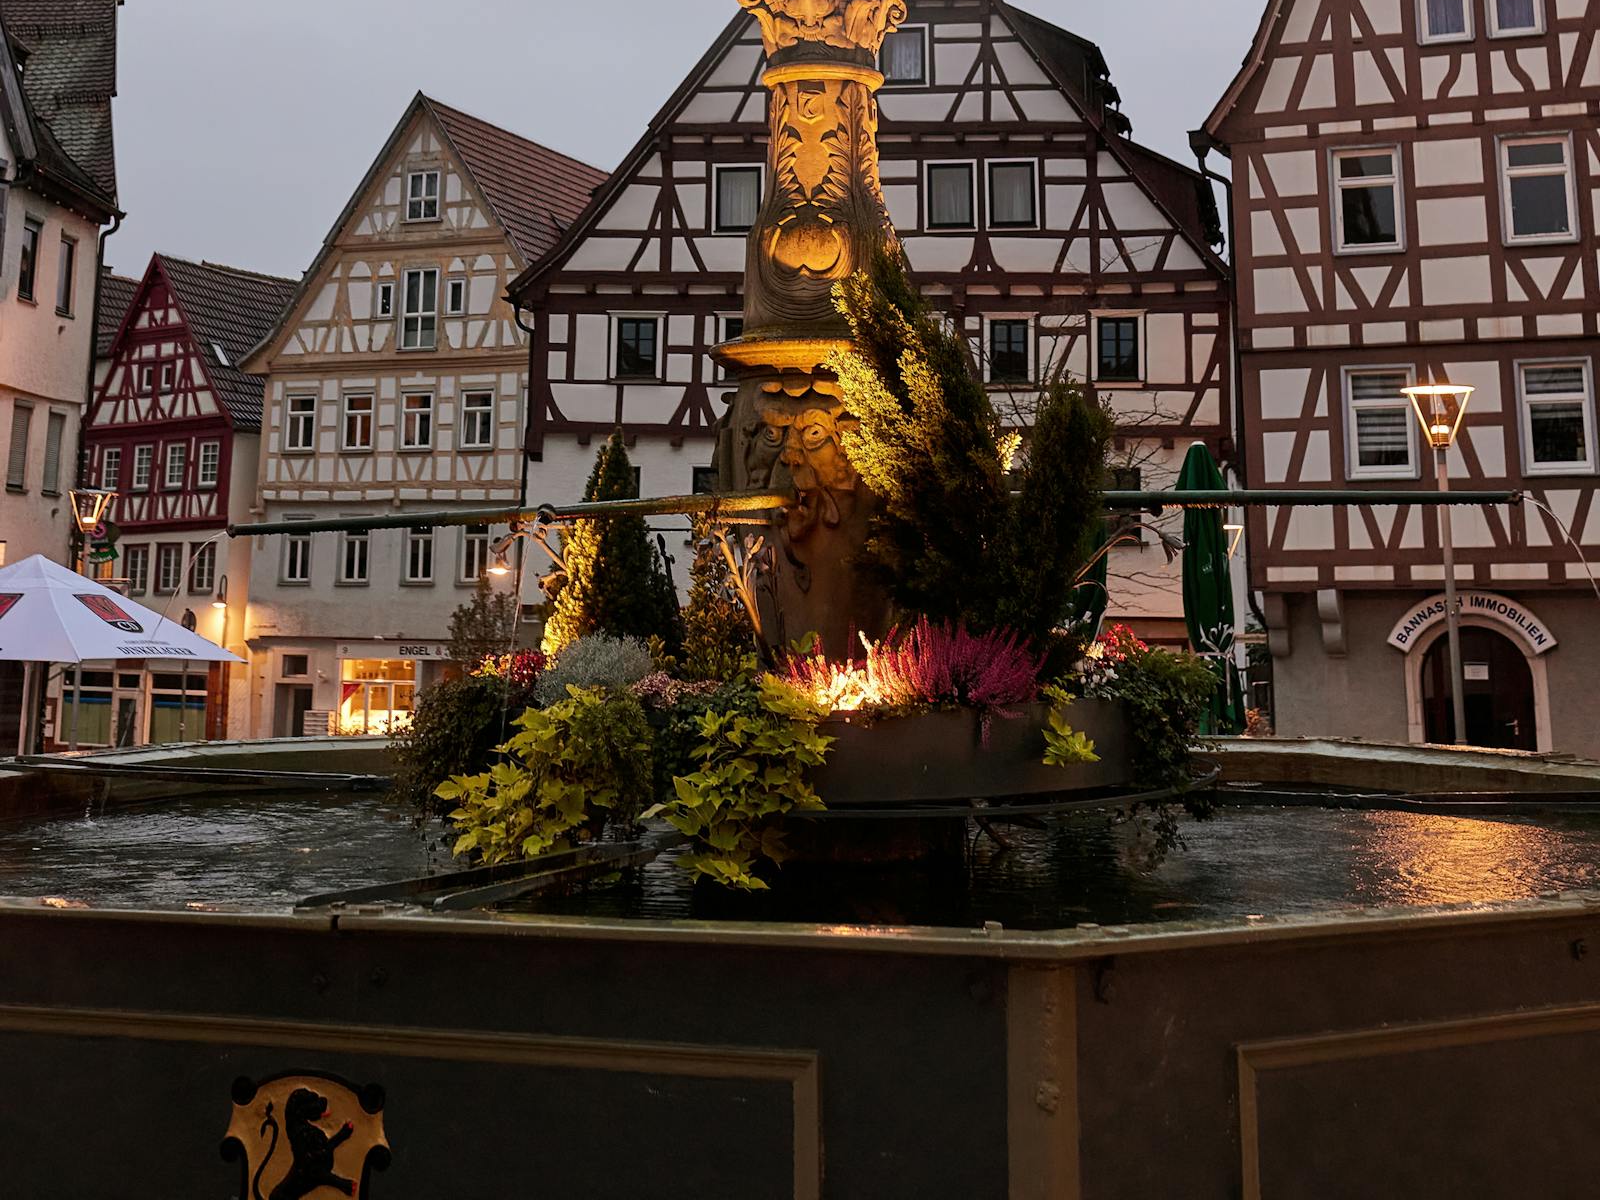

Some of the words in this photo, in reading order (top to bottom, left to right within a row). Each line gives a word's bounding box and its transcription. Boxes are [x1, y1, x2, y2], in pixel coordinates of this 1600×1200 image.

[1470, 596, 1547, 646] IMMOBILIEN
[399, 646, 431, 656] ENGEL
[435, 646, 443, 656] &
